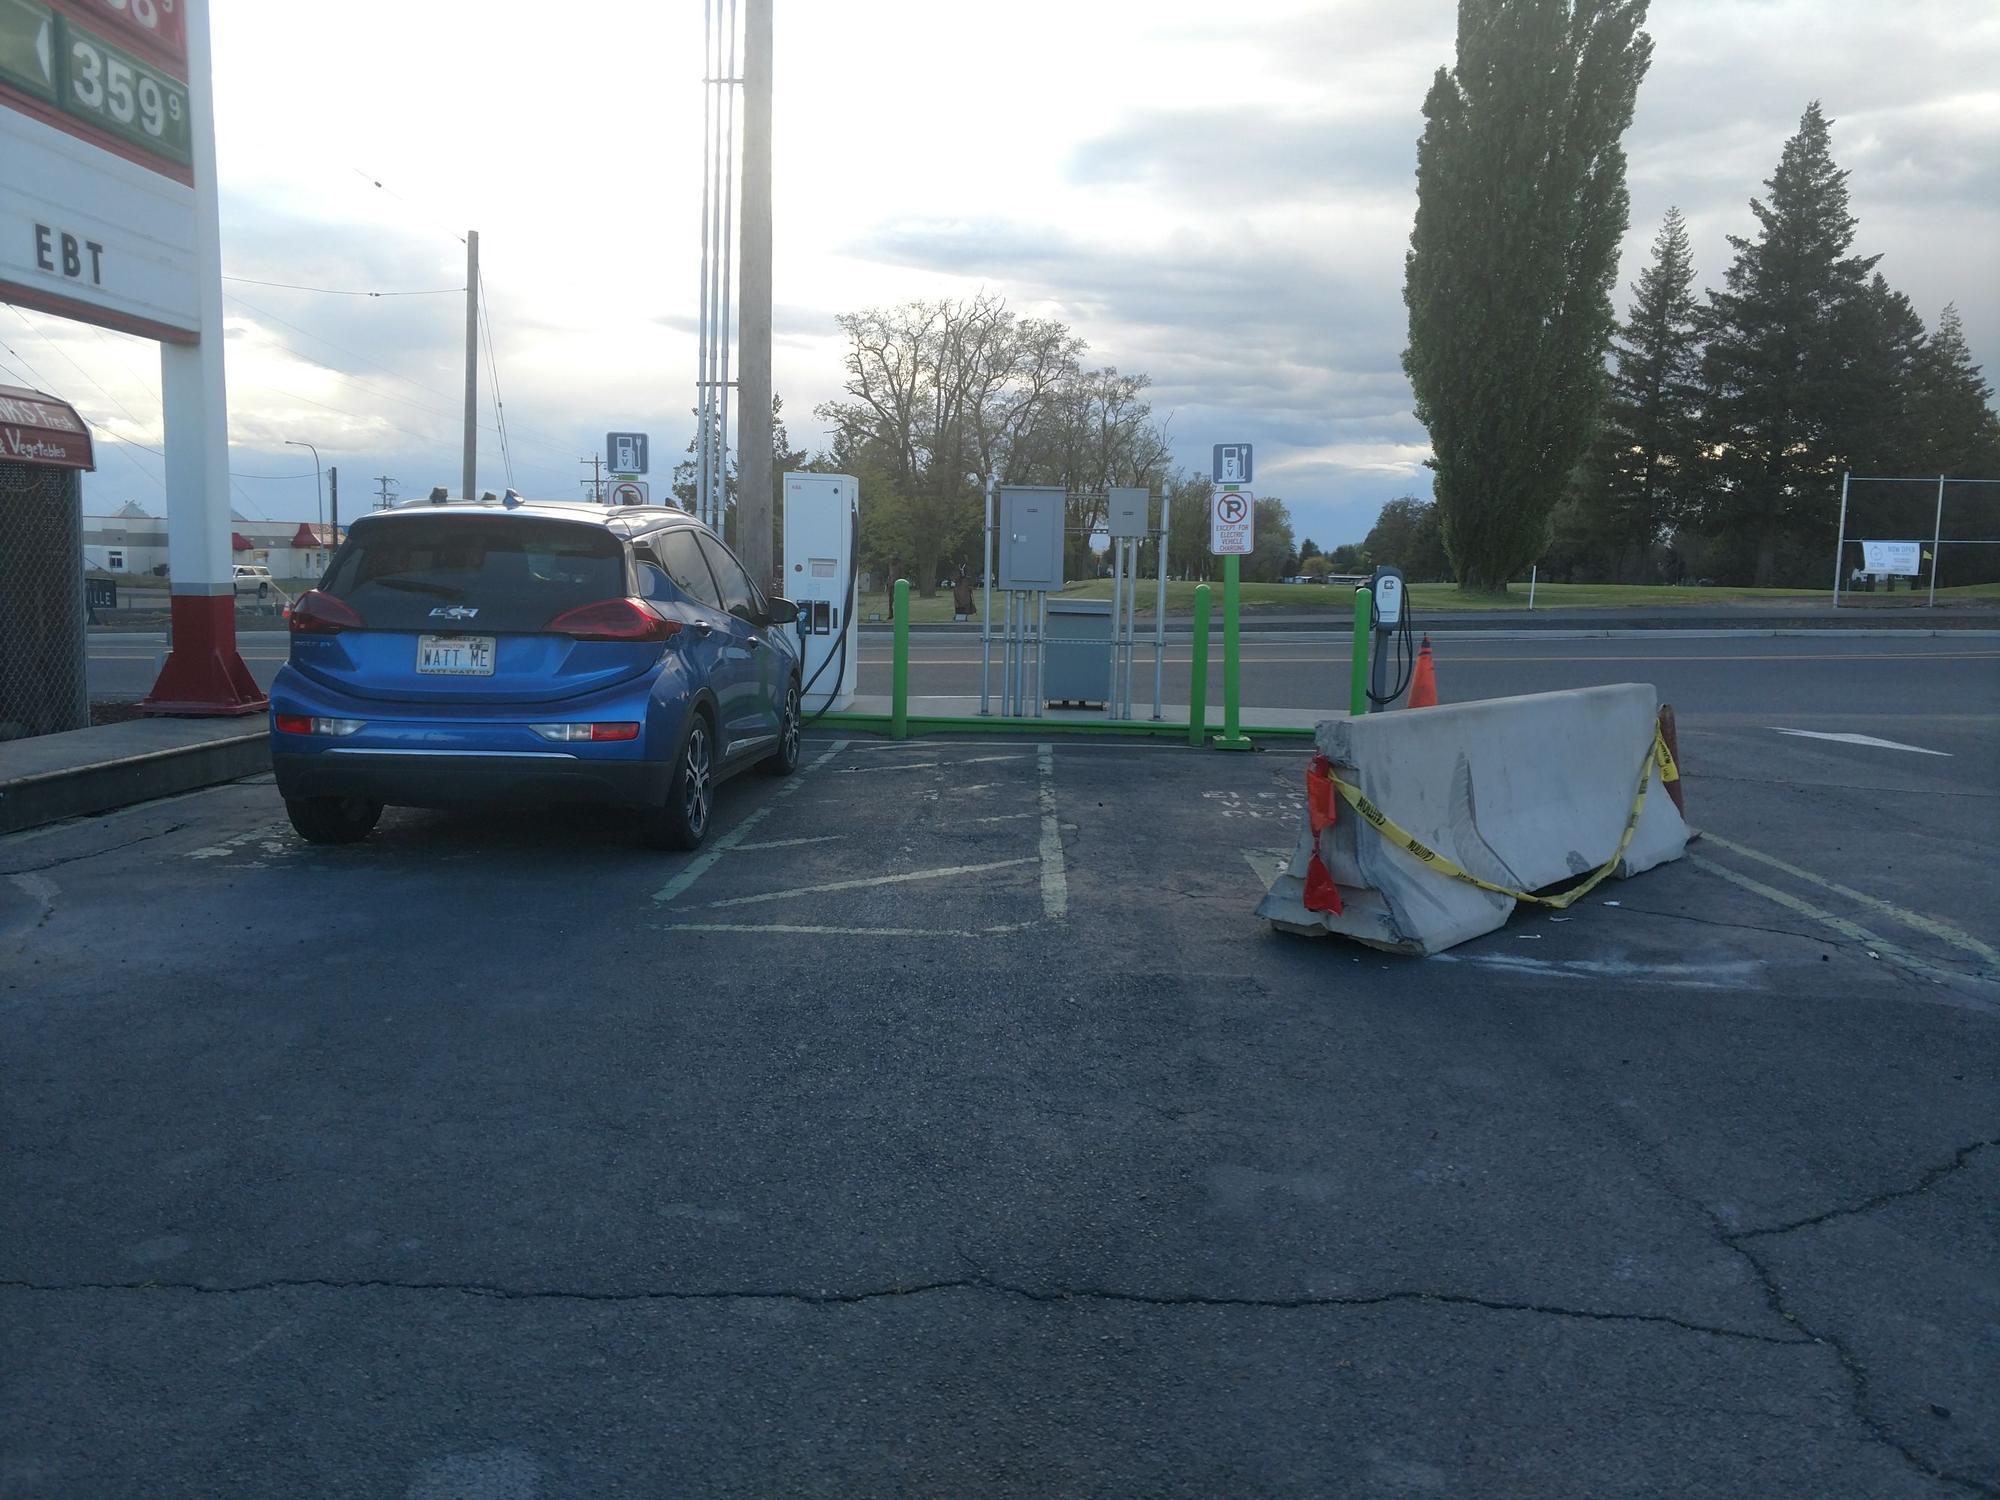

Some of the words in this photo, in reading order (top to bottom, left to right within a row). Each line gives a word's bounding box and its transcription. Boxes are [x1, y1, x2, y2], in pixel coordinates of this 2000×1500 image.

[35, 223, 103, 284] EBT
[5, 428, 66, 459] Vegetables
[424, 649, 460, 666] WATT
[470, 650, 489, 667] ME
